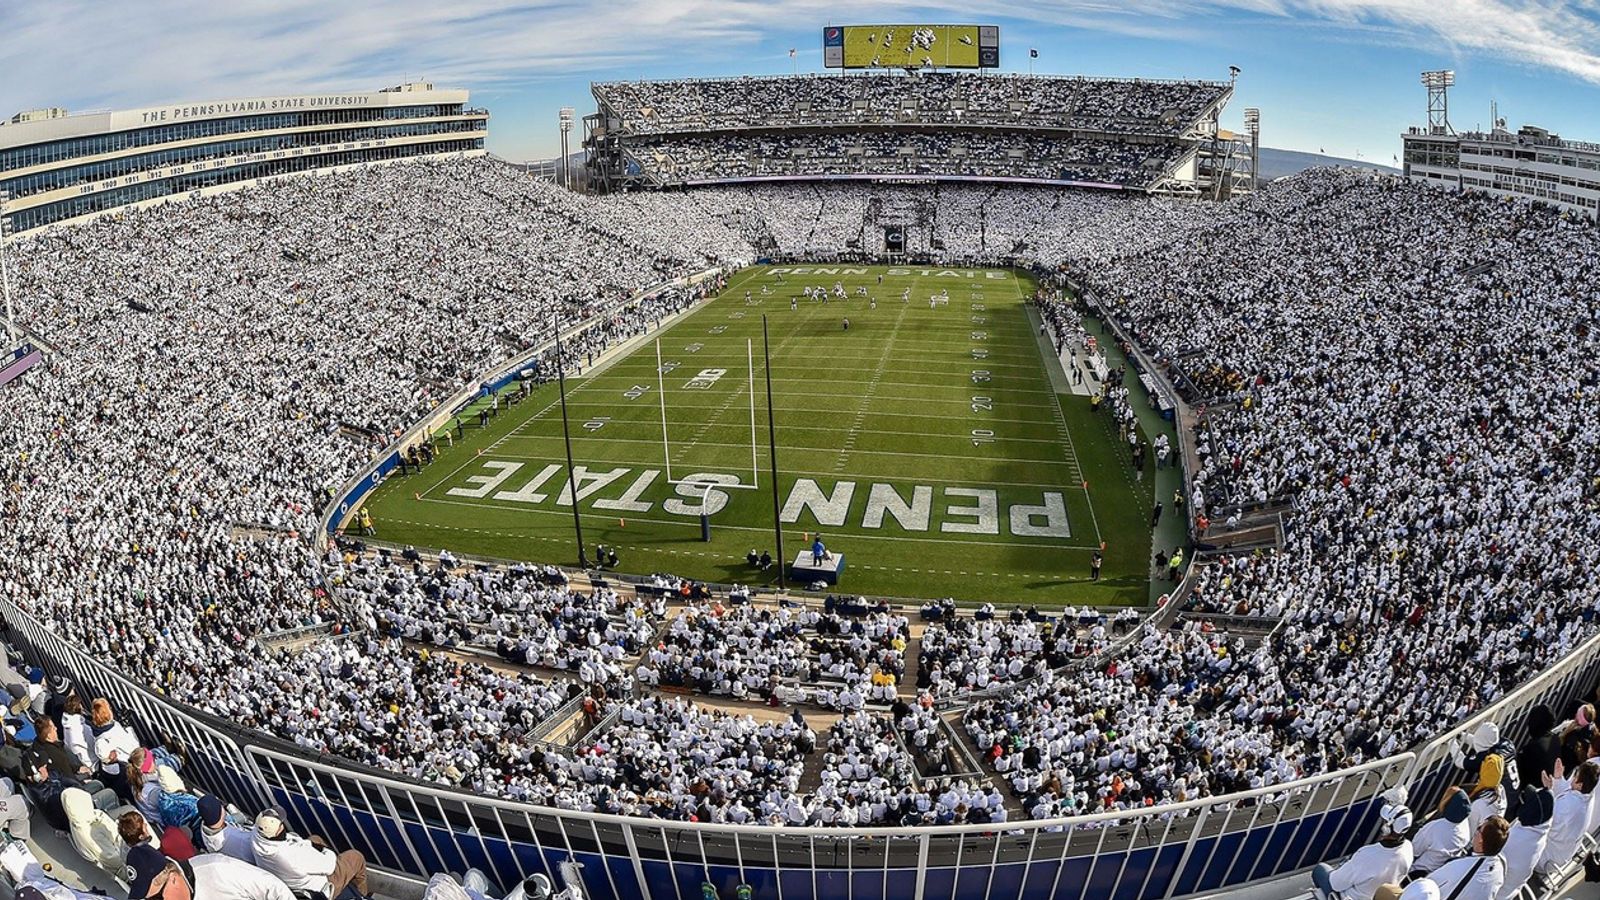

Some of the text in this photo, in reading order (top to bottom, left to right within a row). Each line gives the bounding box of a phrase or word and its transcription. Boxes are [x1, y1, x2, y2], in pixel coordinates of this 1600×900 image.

[142, 96, 369, 123] THE PENNSYLVANIA STATE UNIVERSITY
[1525, 179, 1556, 190] STADIUM
[766, 268, 1008, 280] PENN STATE
[623, 385, 650, 397] 20
[972, 396, 992, 411] 20
[583, 416, 611, 429] 10
[972, 429, 995, 443] 10
[445, 460, 1072, 538] PENN STATE
